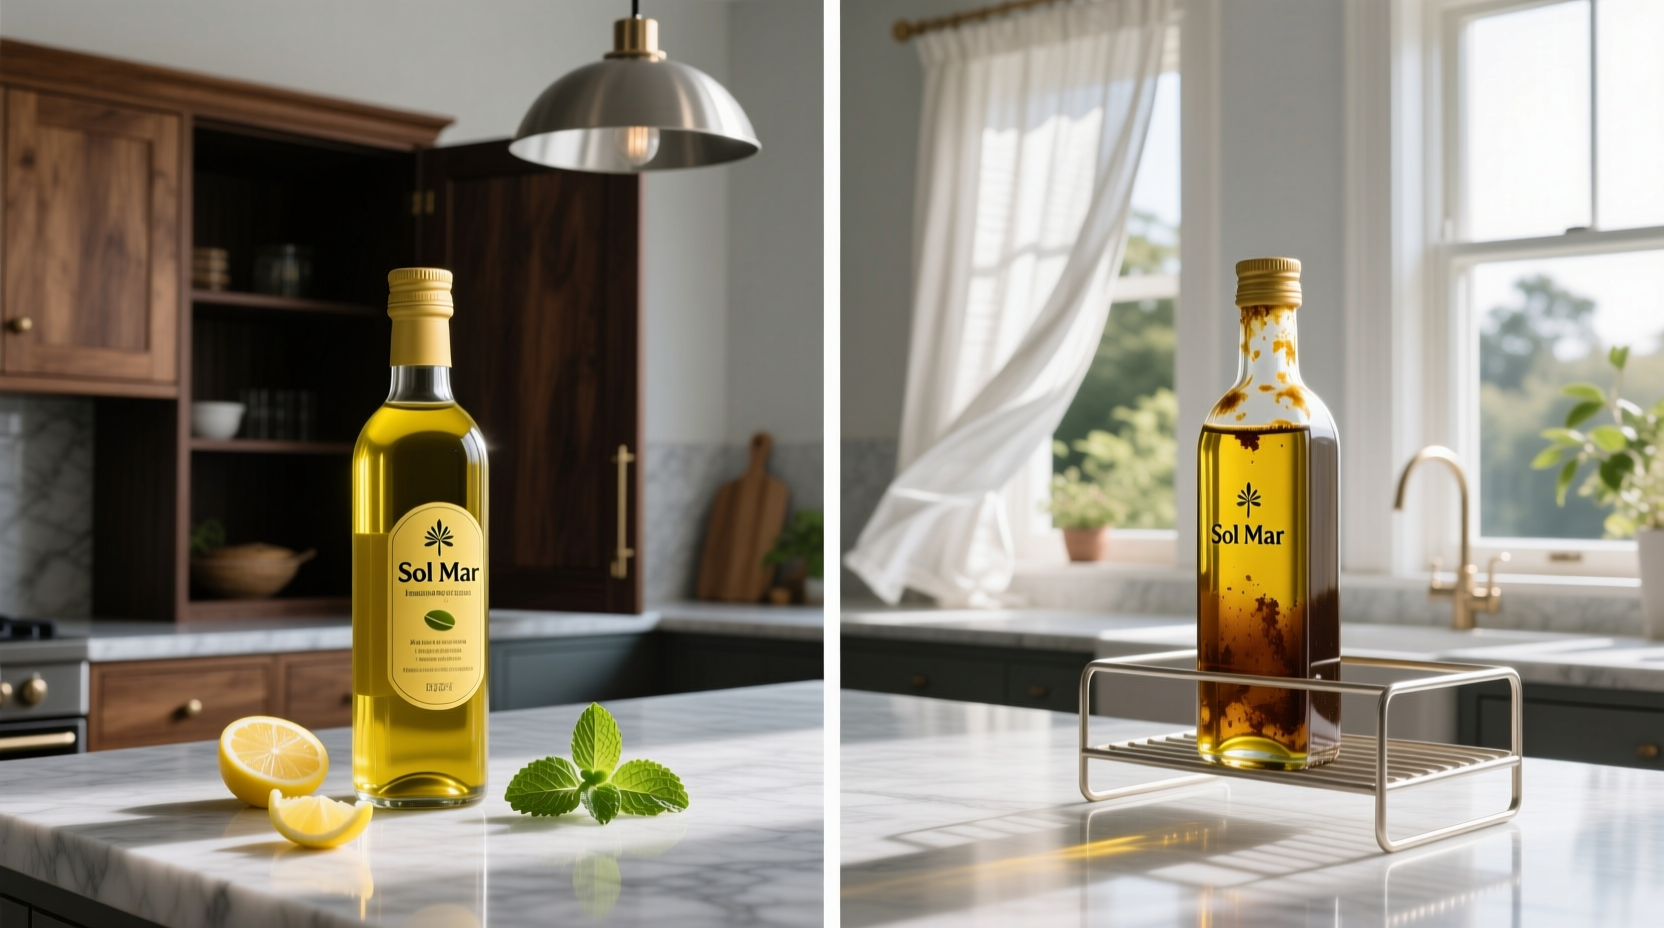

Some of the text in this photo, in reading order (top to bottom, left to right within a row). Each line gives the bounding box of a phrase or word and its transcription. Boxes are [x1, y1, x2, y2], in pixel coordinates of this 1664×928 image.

[1211, 523, 1285, 545] Sol Mar
[398, 561, 480, 583] Sol Mar
